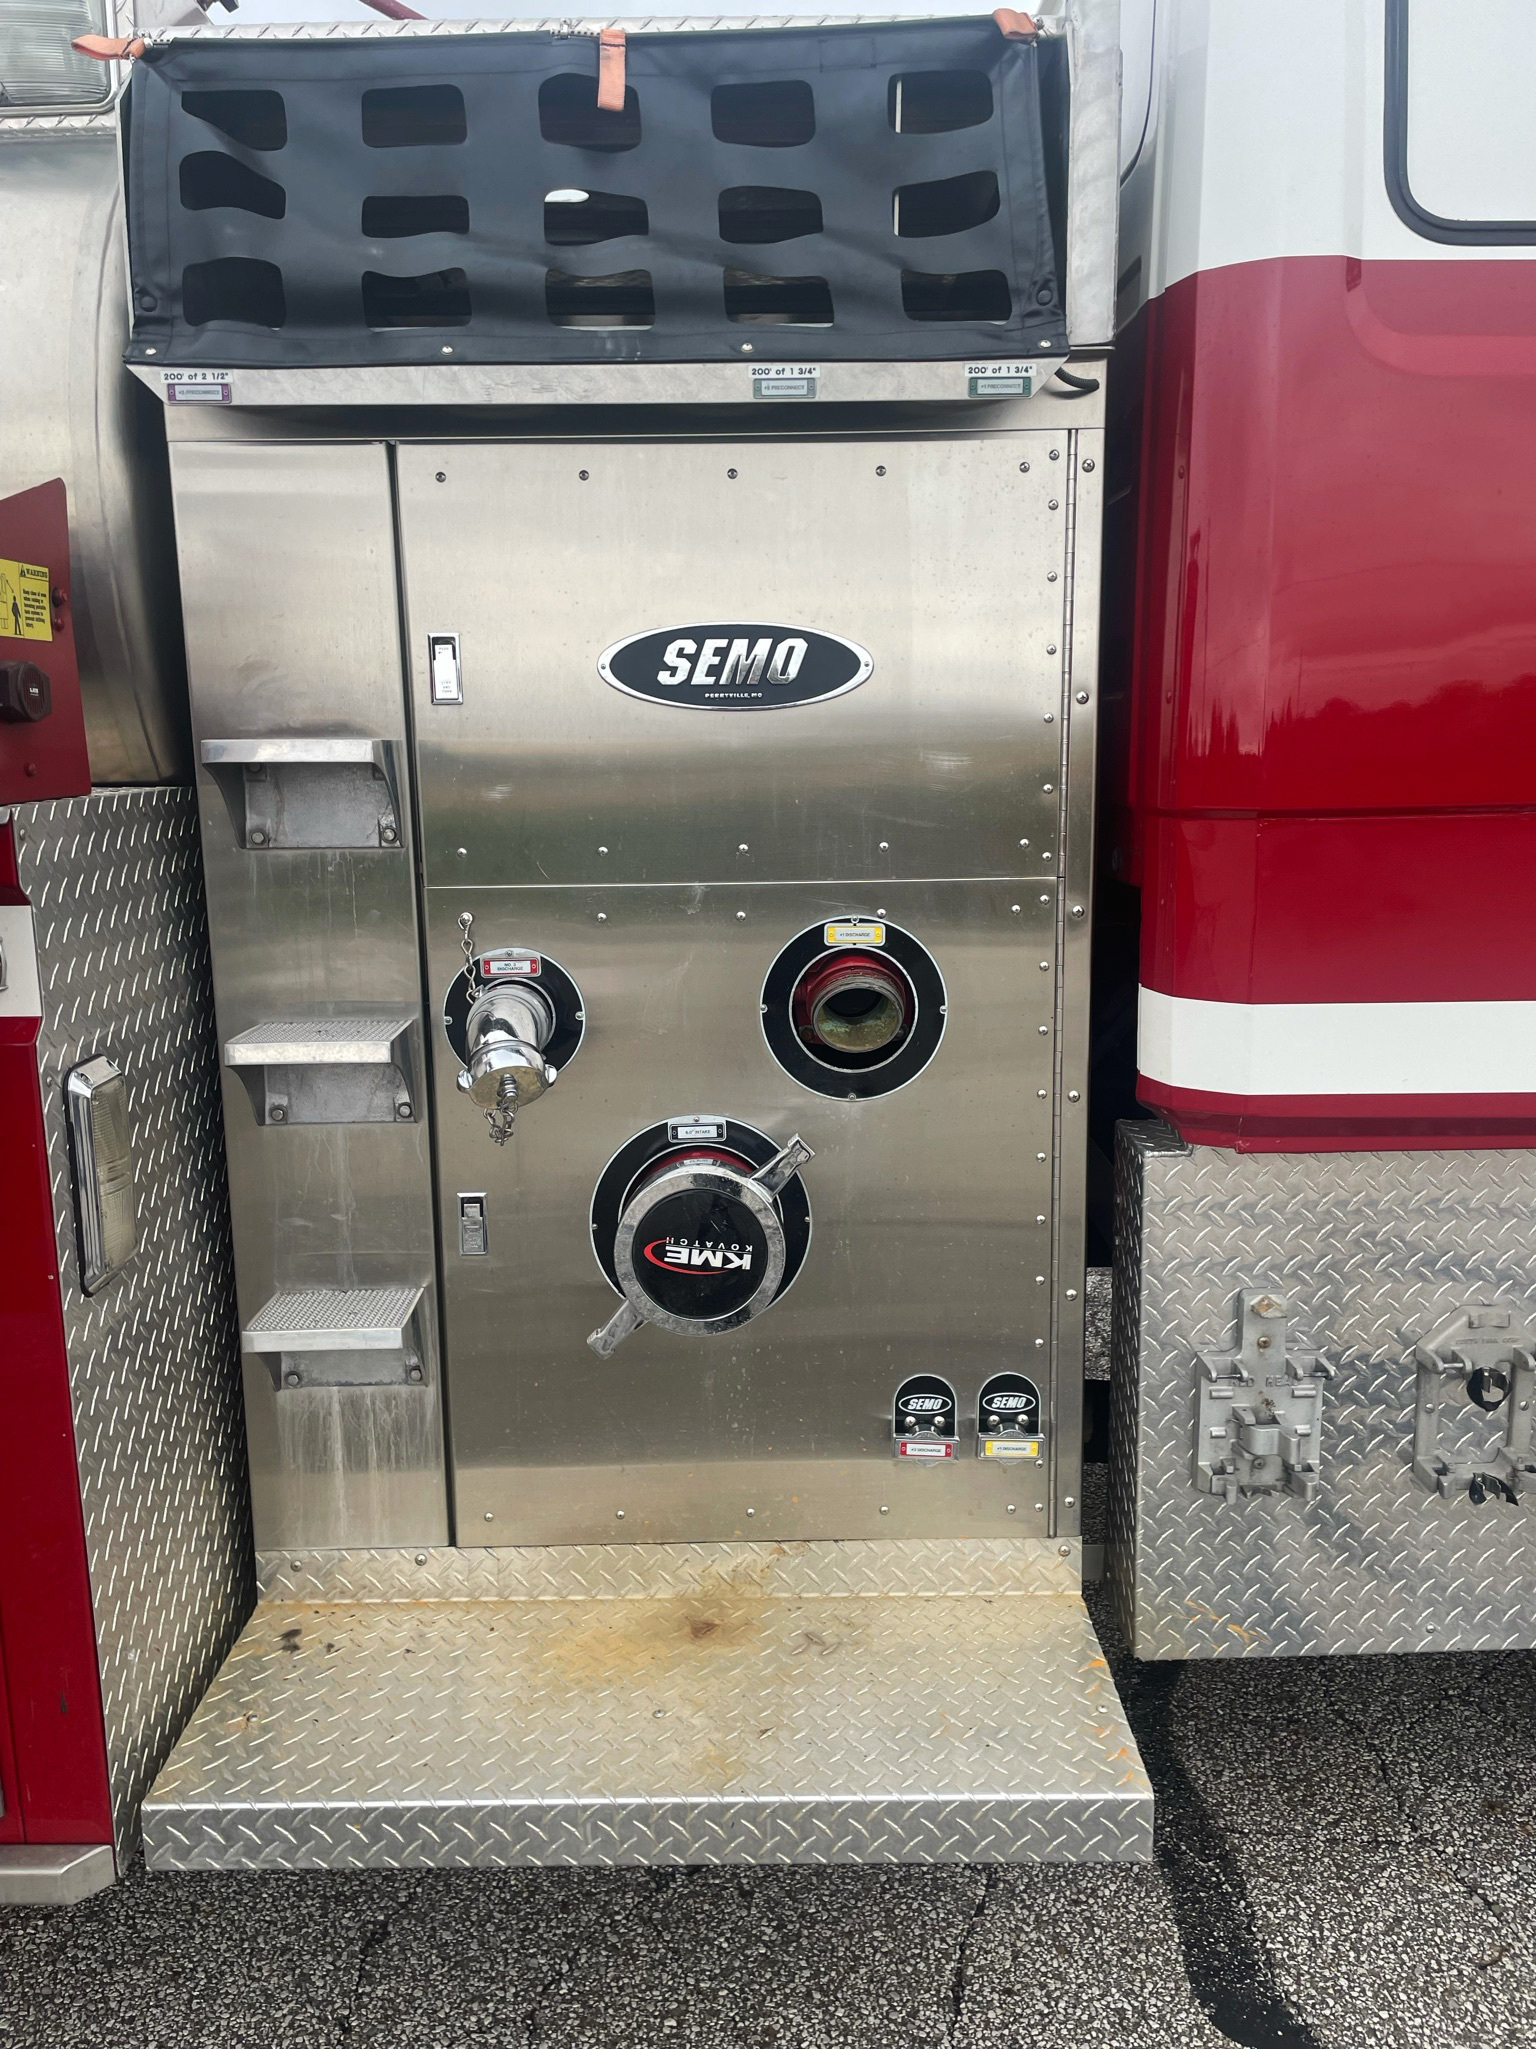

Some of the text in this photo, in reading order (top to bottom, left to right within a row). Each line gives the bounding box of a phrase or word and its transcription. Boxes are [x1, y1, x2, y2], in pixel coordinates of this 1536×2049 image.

[187, 372, 198, 380] of
[211, 372, 229, 380] 1/2"
[775, 367, 786, 375] of
[797, 367, 816, 375] 3/4"
[992, 366, 1002, 374] of
[1014, 366, 1033, 374] 3/4"
[657, 637, 809, 686] SEMO
[665, 1236, 753, 1253] KOVATCH
[664, 1245, 753, 1271] KME
[907, 1398, 943, 1410] SEMO
[991, 1396, 1027, 1409] SEMO
